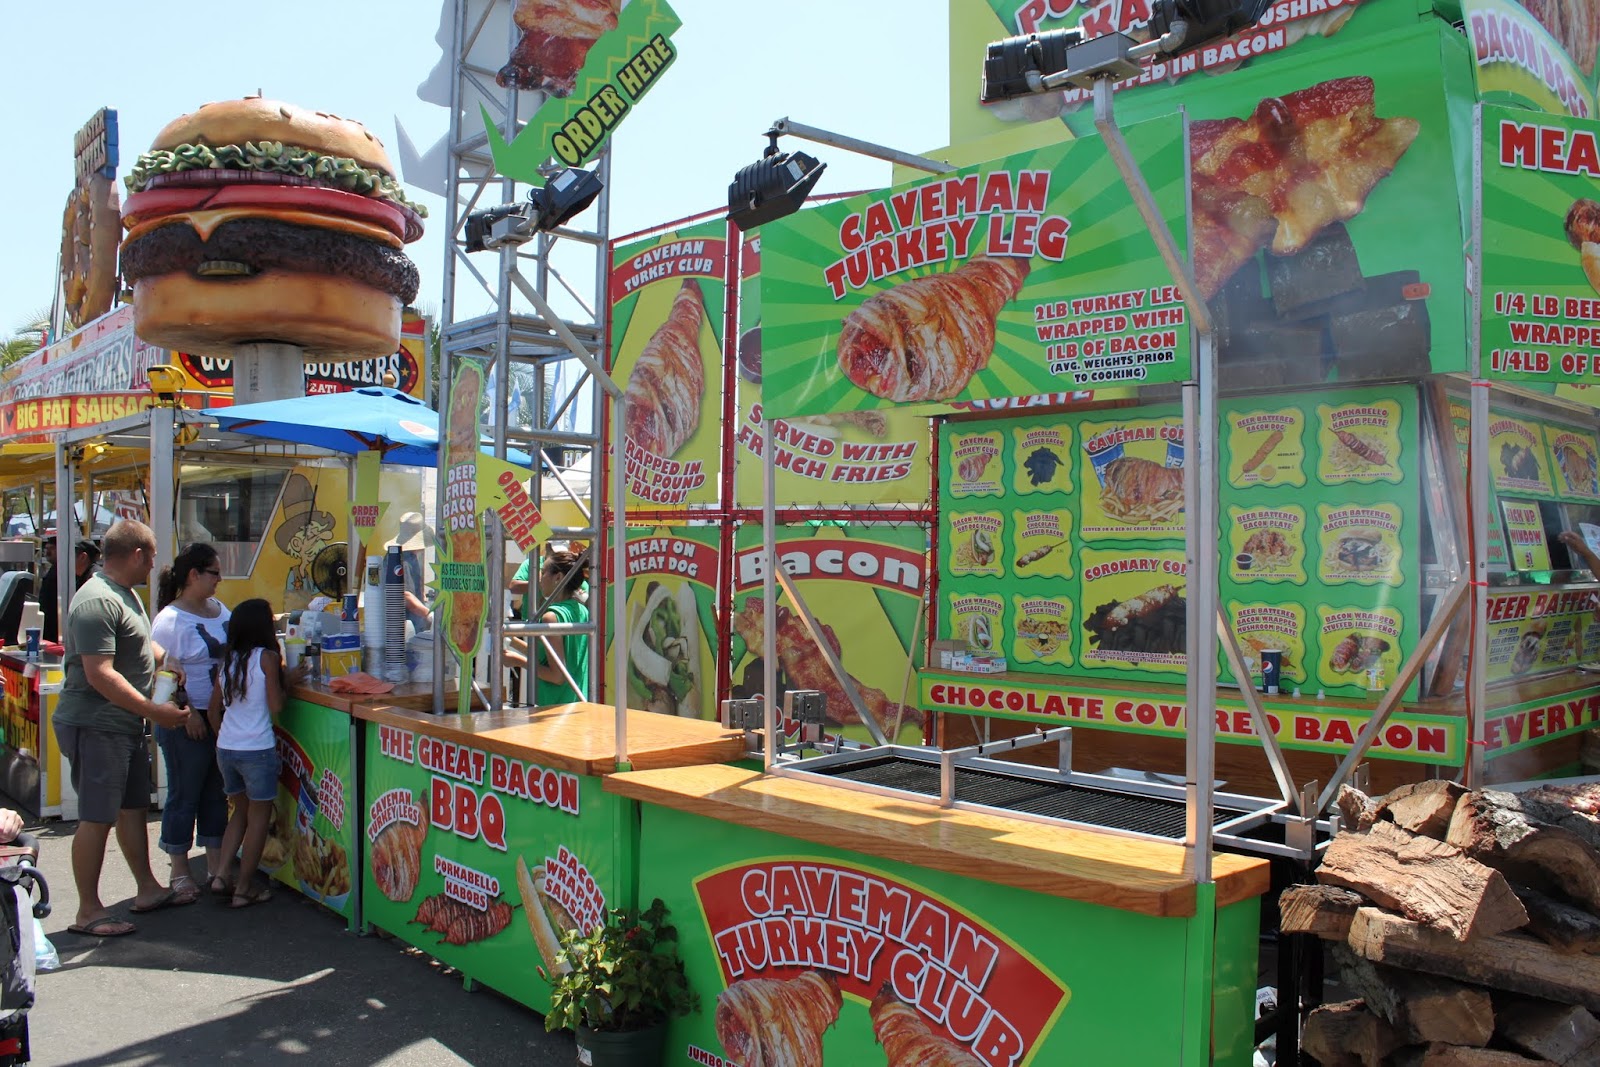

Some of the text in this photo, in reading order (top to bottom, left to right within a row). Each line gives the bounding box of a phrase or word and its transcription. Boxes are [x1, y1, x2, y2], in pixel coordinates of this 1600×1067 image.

[1172, 29, 1284, 75] IN BACON
[1471, 9, 1540, 78] BACON
[552, 33, 674, 167] ORDER HERE
[839, 169, 1051, 252] CAVEMAN
[633, 240, 704, 270] CAVEMAN
[823, 212, 1071, 301] TURKEY LEG
[624, 258, 713, 292] TURKEY CLUB
[1072, 290, 1146, 316] TURKEY
[1494, 292, 1526, 315] 1/4
[1531, 294, 1560, 318] LB
[1037, 306, 1184, 341] WRAPPED WITH
[1082, 340, 1105, 357] OF
[1110, 331, 1177, 354] BACON
[1050, 351, 1174, 375] (AVG. WEIGHTS PRIOR
[1561, 353, 1588, 375] OF
[1074, 367, 1147, 383] TO COOKING)
[16, 398, 72, 431] BIG FAT
[1237, 415, 1295, 428] BEER BATTERED
[1331, 407, 1389, 421] PORKABELLO
[1332, 416, 1389, 431] KABOB PLATE
[748, 403, 919, 462] SRVED WITH
[1026, 430, 1059, 440] CHOCOLATE
[1246, 423, 1287, 434] BACON DOG
[960, 437, 995, 447] CAVEMAN
[1021, 438, 1065, 449] COVERED BACON
[1088, 427, 1156, 453] CAVEMAN
[737, 424, 913, 483] FRNCH FRIES
[955, 446, 999, 458] TURKEY CLUB
[448, 464, 476, 482] DEEP
[682, 459, 704, 476] IN
[445, 480, 477, 502] FRIED
[651, 472, 706, 490] POUND
[496, 470, 542, 530] ORDER
[630, 481, 688, 504] BACON!
[352, 505, 379, 517] ORDER
[442, 498, 476, 520] BACO
[1026, 514, 1059, 523] DEEP FRIED
[1236, 511, 1299, 524] BEER BATTERED
[1328, 509, 1392, 521] BEER BATTERED
[354, 516, 376, 527] HERE
[450, 513, 476, 532] DOG
[497, 502, 537, 551] HERE
[953, 515, 1002, 528] BACON WRAPPED
[957, 524, 968, 533] HOT
[980, 523, 997, 533] PLATE
[1026, 522, 1059, 530] CHOCOLATE
[1243, 520, 1293, 531] BACON PLATE
[1323, 518, 1397, 532] BACON SANDWHICH
[1021, 528, 1064, 539] COVERED BACON
[1510, 529, 1542, 546] WINDOW
[628, 539, 696, 558] MEAT ON
[442, 563, 484, 577] AS FEATURED ON
[629, 556, 699, 577] MEAT DOG
[739, 549, 921, 590] Bacon
[1084, 559, 1161, 581] CORONARY
[953, 597, 1002, 610] BACON WRAPPED
[957, 605, 998, 616] SAUSAGE PLATE
[1021, 600, 1065, 611] GARLIC BUTTER
[1025, 608, 1061, 617] BACON FRIES
[1237, 607, 1296, 620] BEER BATTERED
[1236, 615, 1297, 629] BACON WRAPPED
[1323, 621, 1354, 634] STUFFED
[1325, 612, 1395, 626] BACON WRAPPED
[1236, 624, 1297, 638] MUSHROOM PLATE
[930, 684, 1104, 720] CHOCOLATE
[1114, 701, 1281, 736] COVRED
[323, 768, 344, 793] SOUR
[379, 724, 579, 816] THE GREAT BACON
[320, 778, 345, 812] CREAM
[370, 788, 412, 819] CAVEMAN
[318, 789, 344, 825] BACON
[320, 801, 341, 832] FRIES
[430, 775, 507, 852] BBQ
[367, 803, 420, 844] TURKEY LEGS
[434, 854, 500, 898] PORKABELLO
[557, 844, 605, 914] BACON
[444, 879, 488, 912] KABOBS
[545, 856, 605, 928] WRAPPE
[544, 876, 592, 938] SAUSAG
[740, 865, 999, 993] CAVEMAN
[714, 915, 1025, 1067] TURKEY CLUB
